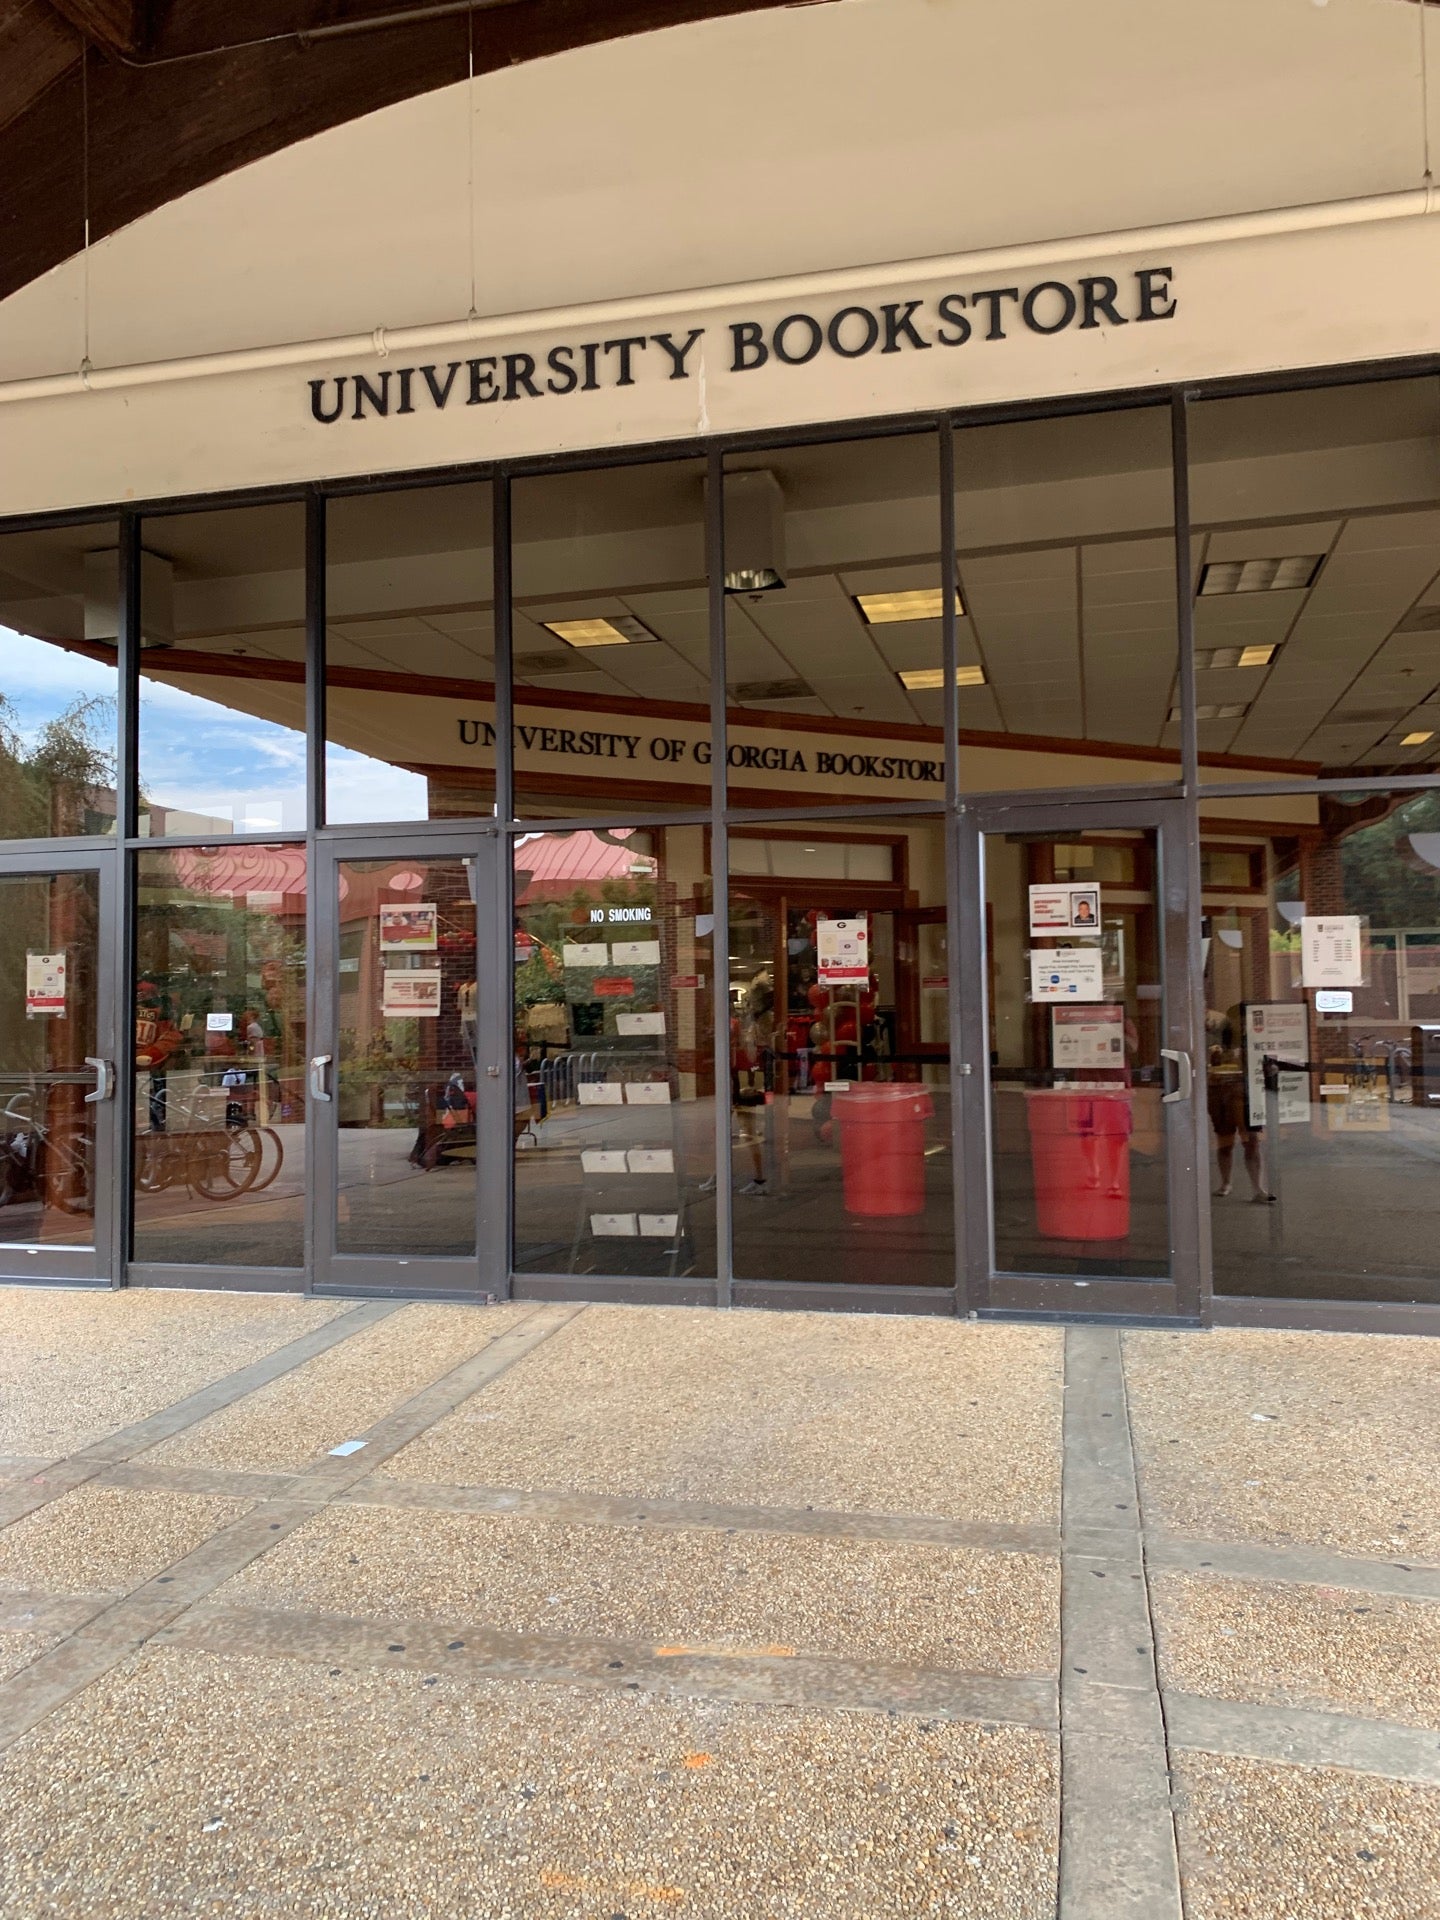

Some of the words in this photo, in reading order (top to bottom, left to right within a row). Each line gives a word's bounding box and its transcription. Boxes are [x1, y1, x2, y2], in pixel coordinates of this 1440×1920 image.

[307, 328, 706, 425] UNIVERSITY
[728, 266, 1178, 374] BOOKSTORE
[457, 719, 642, 759] UNVERSITY
[650, 737, 686, 762] OF
[693, 741, 808, 773] GORGIA
[590, 909, 604, 922] NO
[608, 907, 652, 922] SMOKING
